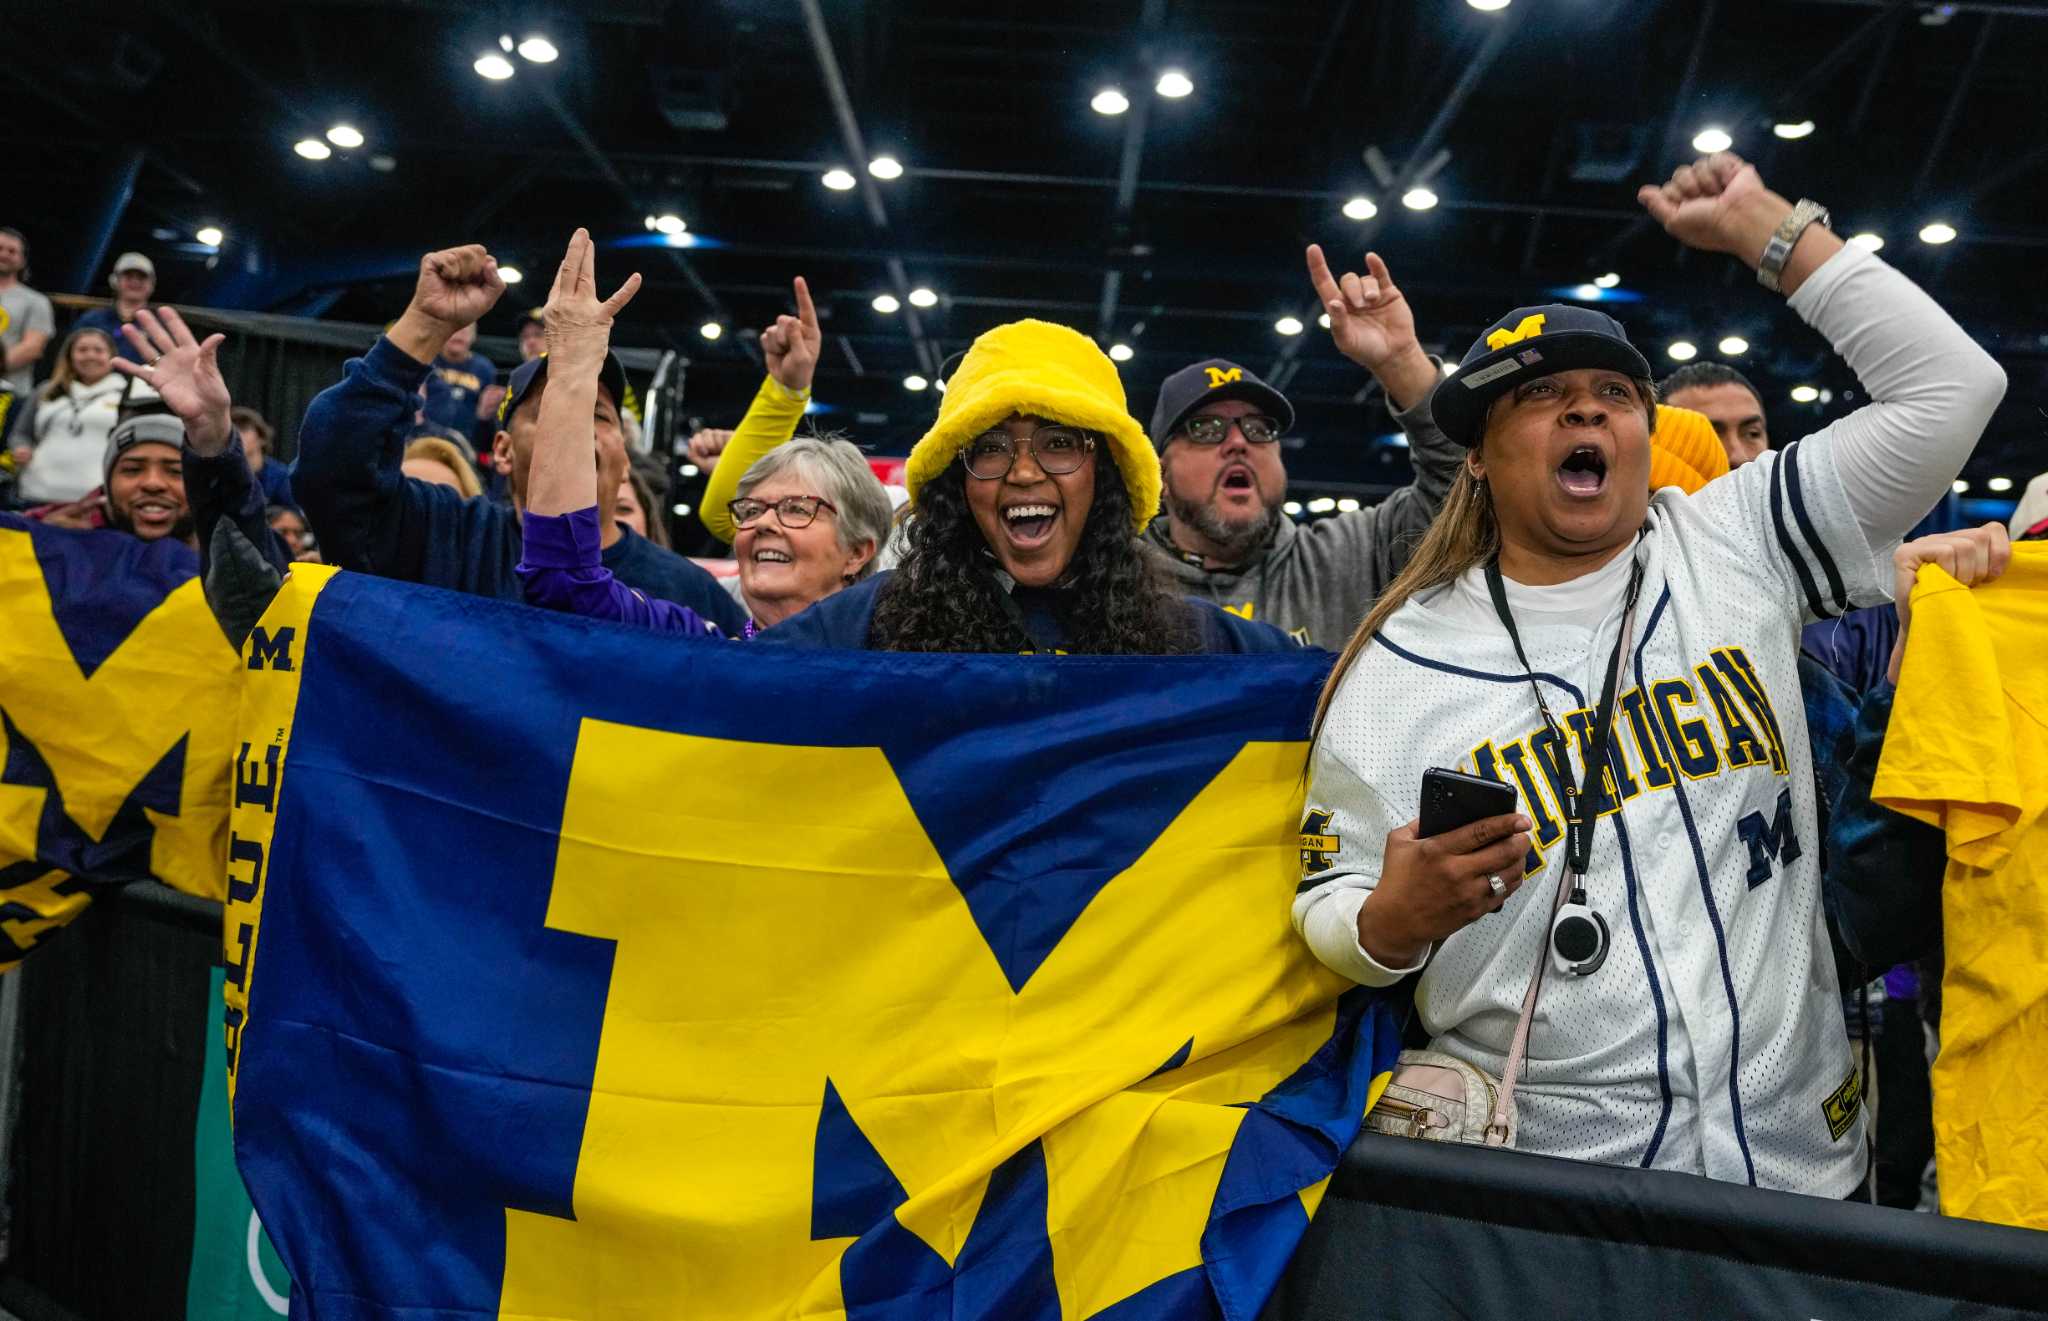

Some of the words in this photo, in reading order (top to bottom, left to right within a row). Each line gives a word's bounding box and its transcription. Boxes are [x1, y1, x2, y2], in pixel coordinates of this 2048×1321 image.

[1486, 313, 1546, 352] M
[1204, 367, 1243, 389] M
[248, 626, 296, 671] M
[1737, 787, 1802, 892] M
[498, 717, 1352, 1321] M
